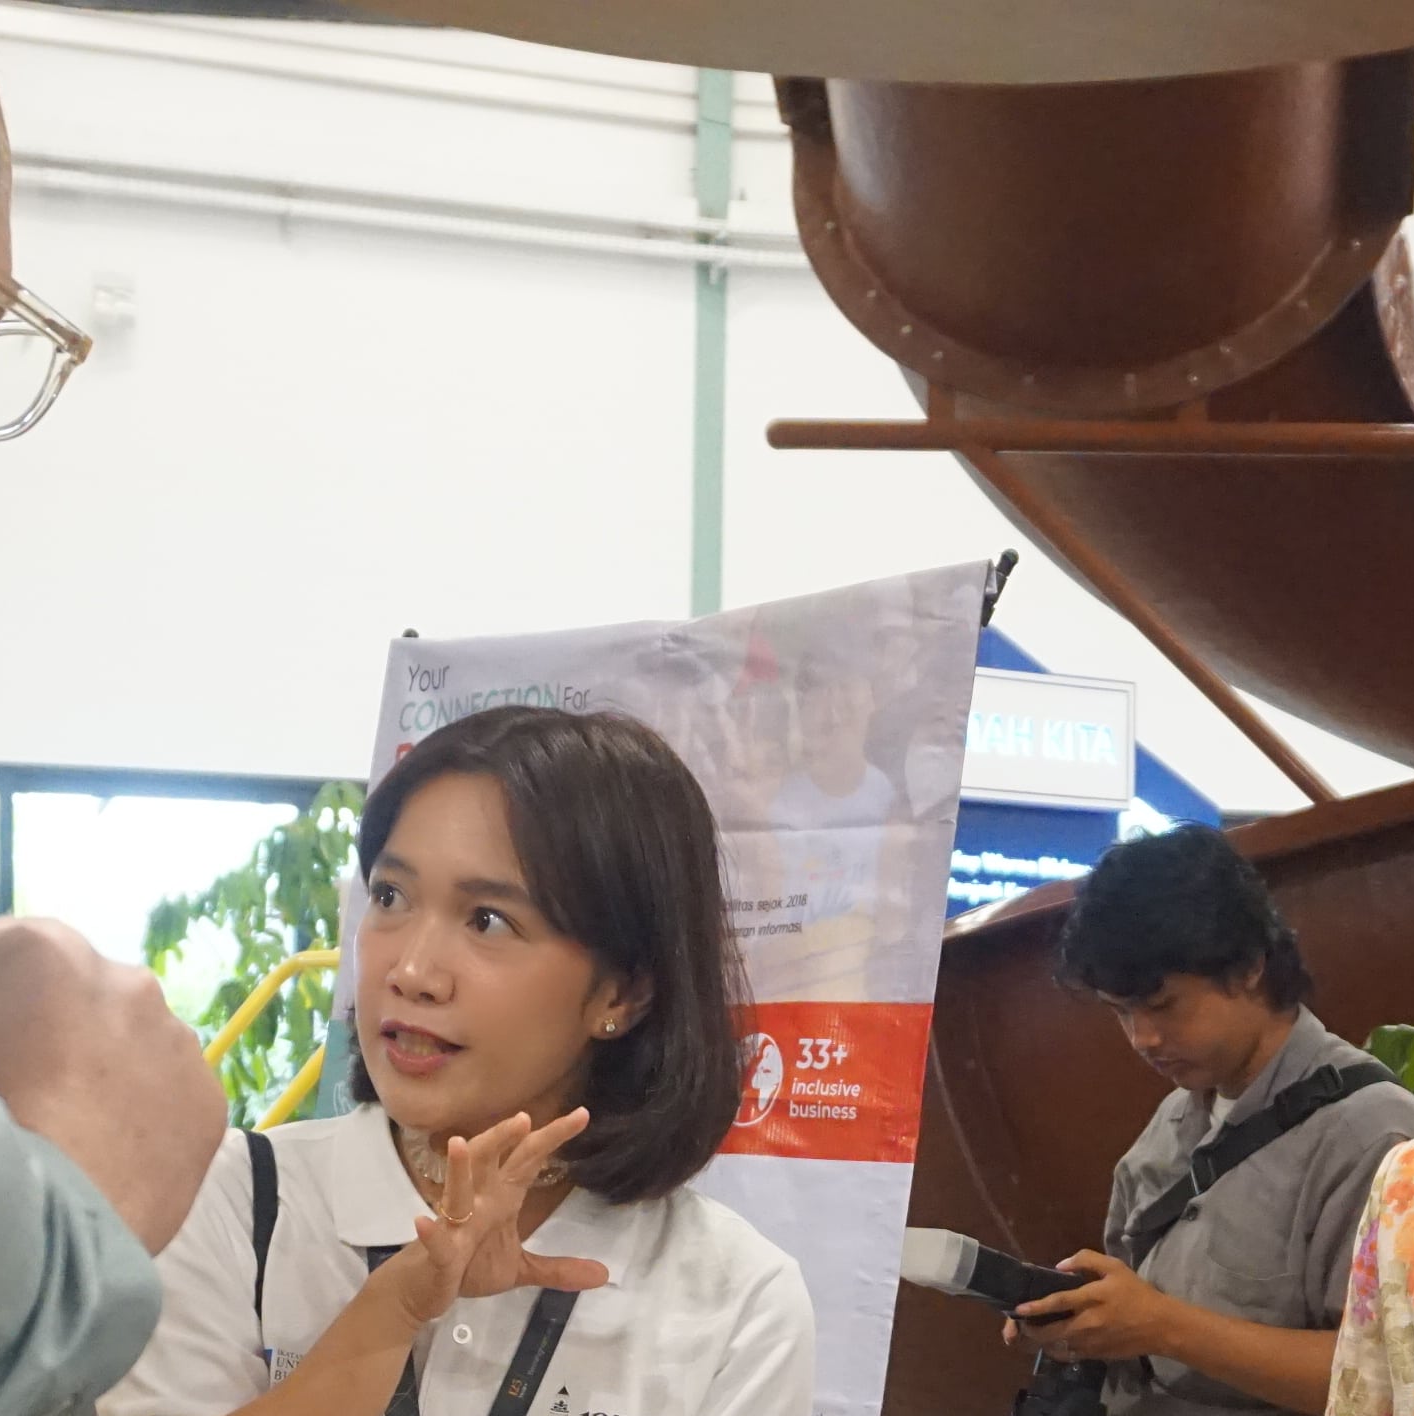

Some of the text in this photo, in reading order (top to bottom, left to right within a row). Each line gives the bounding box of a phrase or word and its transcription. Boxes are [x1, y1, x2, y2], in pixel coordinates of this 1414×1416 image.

[408, 664, 450, 692] Your
[563, 686, 591, 712] For
[1041, 718, 1119, 766] KITA
[795, 1037, 849, 1070] 33+
[791, 1077, 861, 1097] inclusive
[789, 1100, 858, 1120] business
